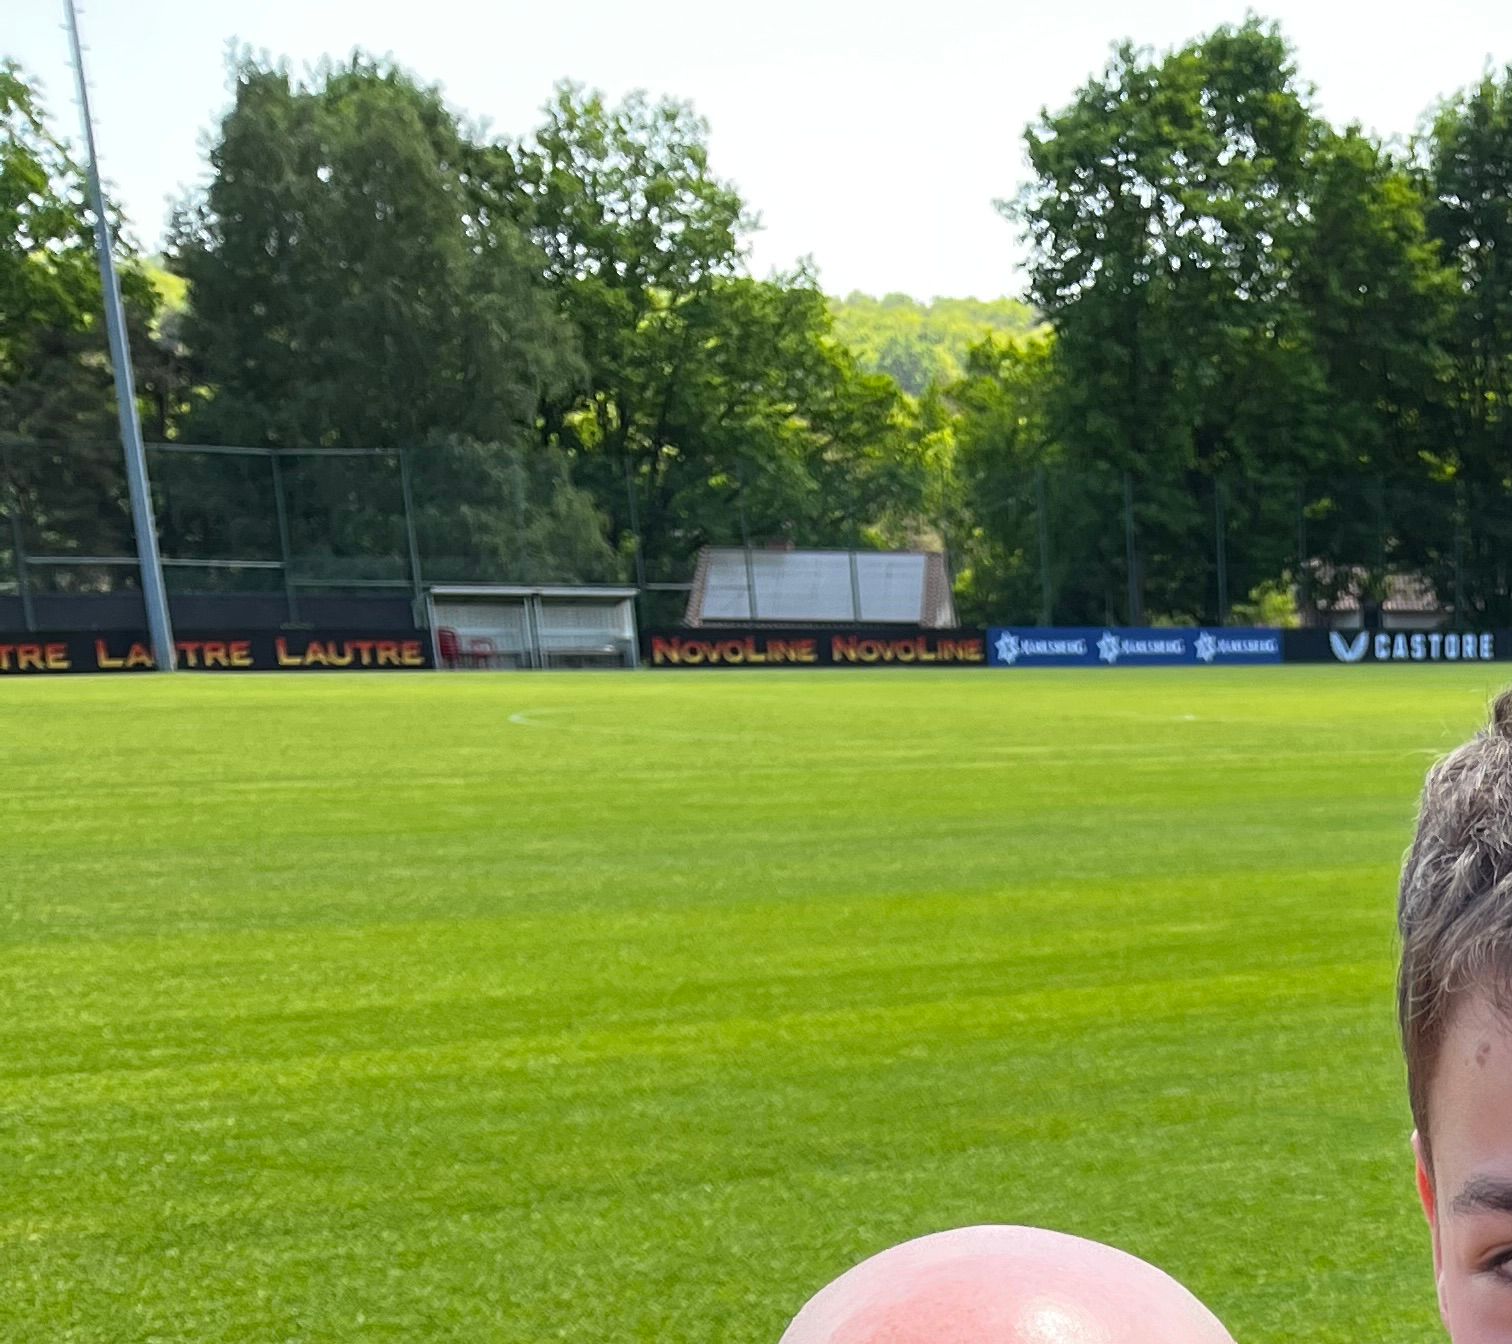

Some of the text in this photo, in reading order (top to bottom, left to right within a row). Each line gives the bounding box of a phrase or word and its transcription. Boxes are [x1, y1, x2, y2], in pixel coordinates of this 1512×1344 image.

[95, 639, 253, 669] LATRE
[276, 637, 425, 666] LAUTRE
[1374, 633, 1495, 660] CASTORE
